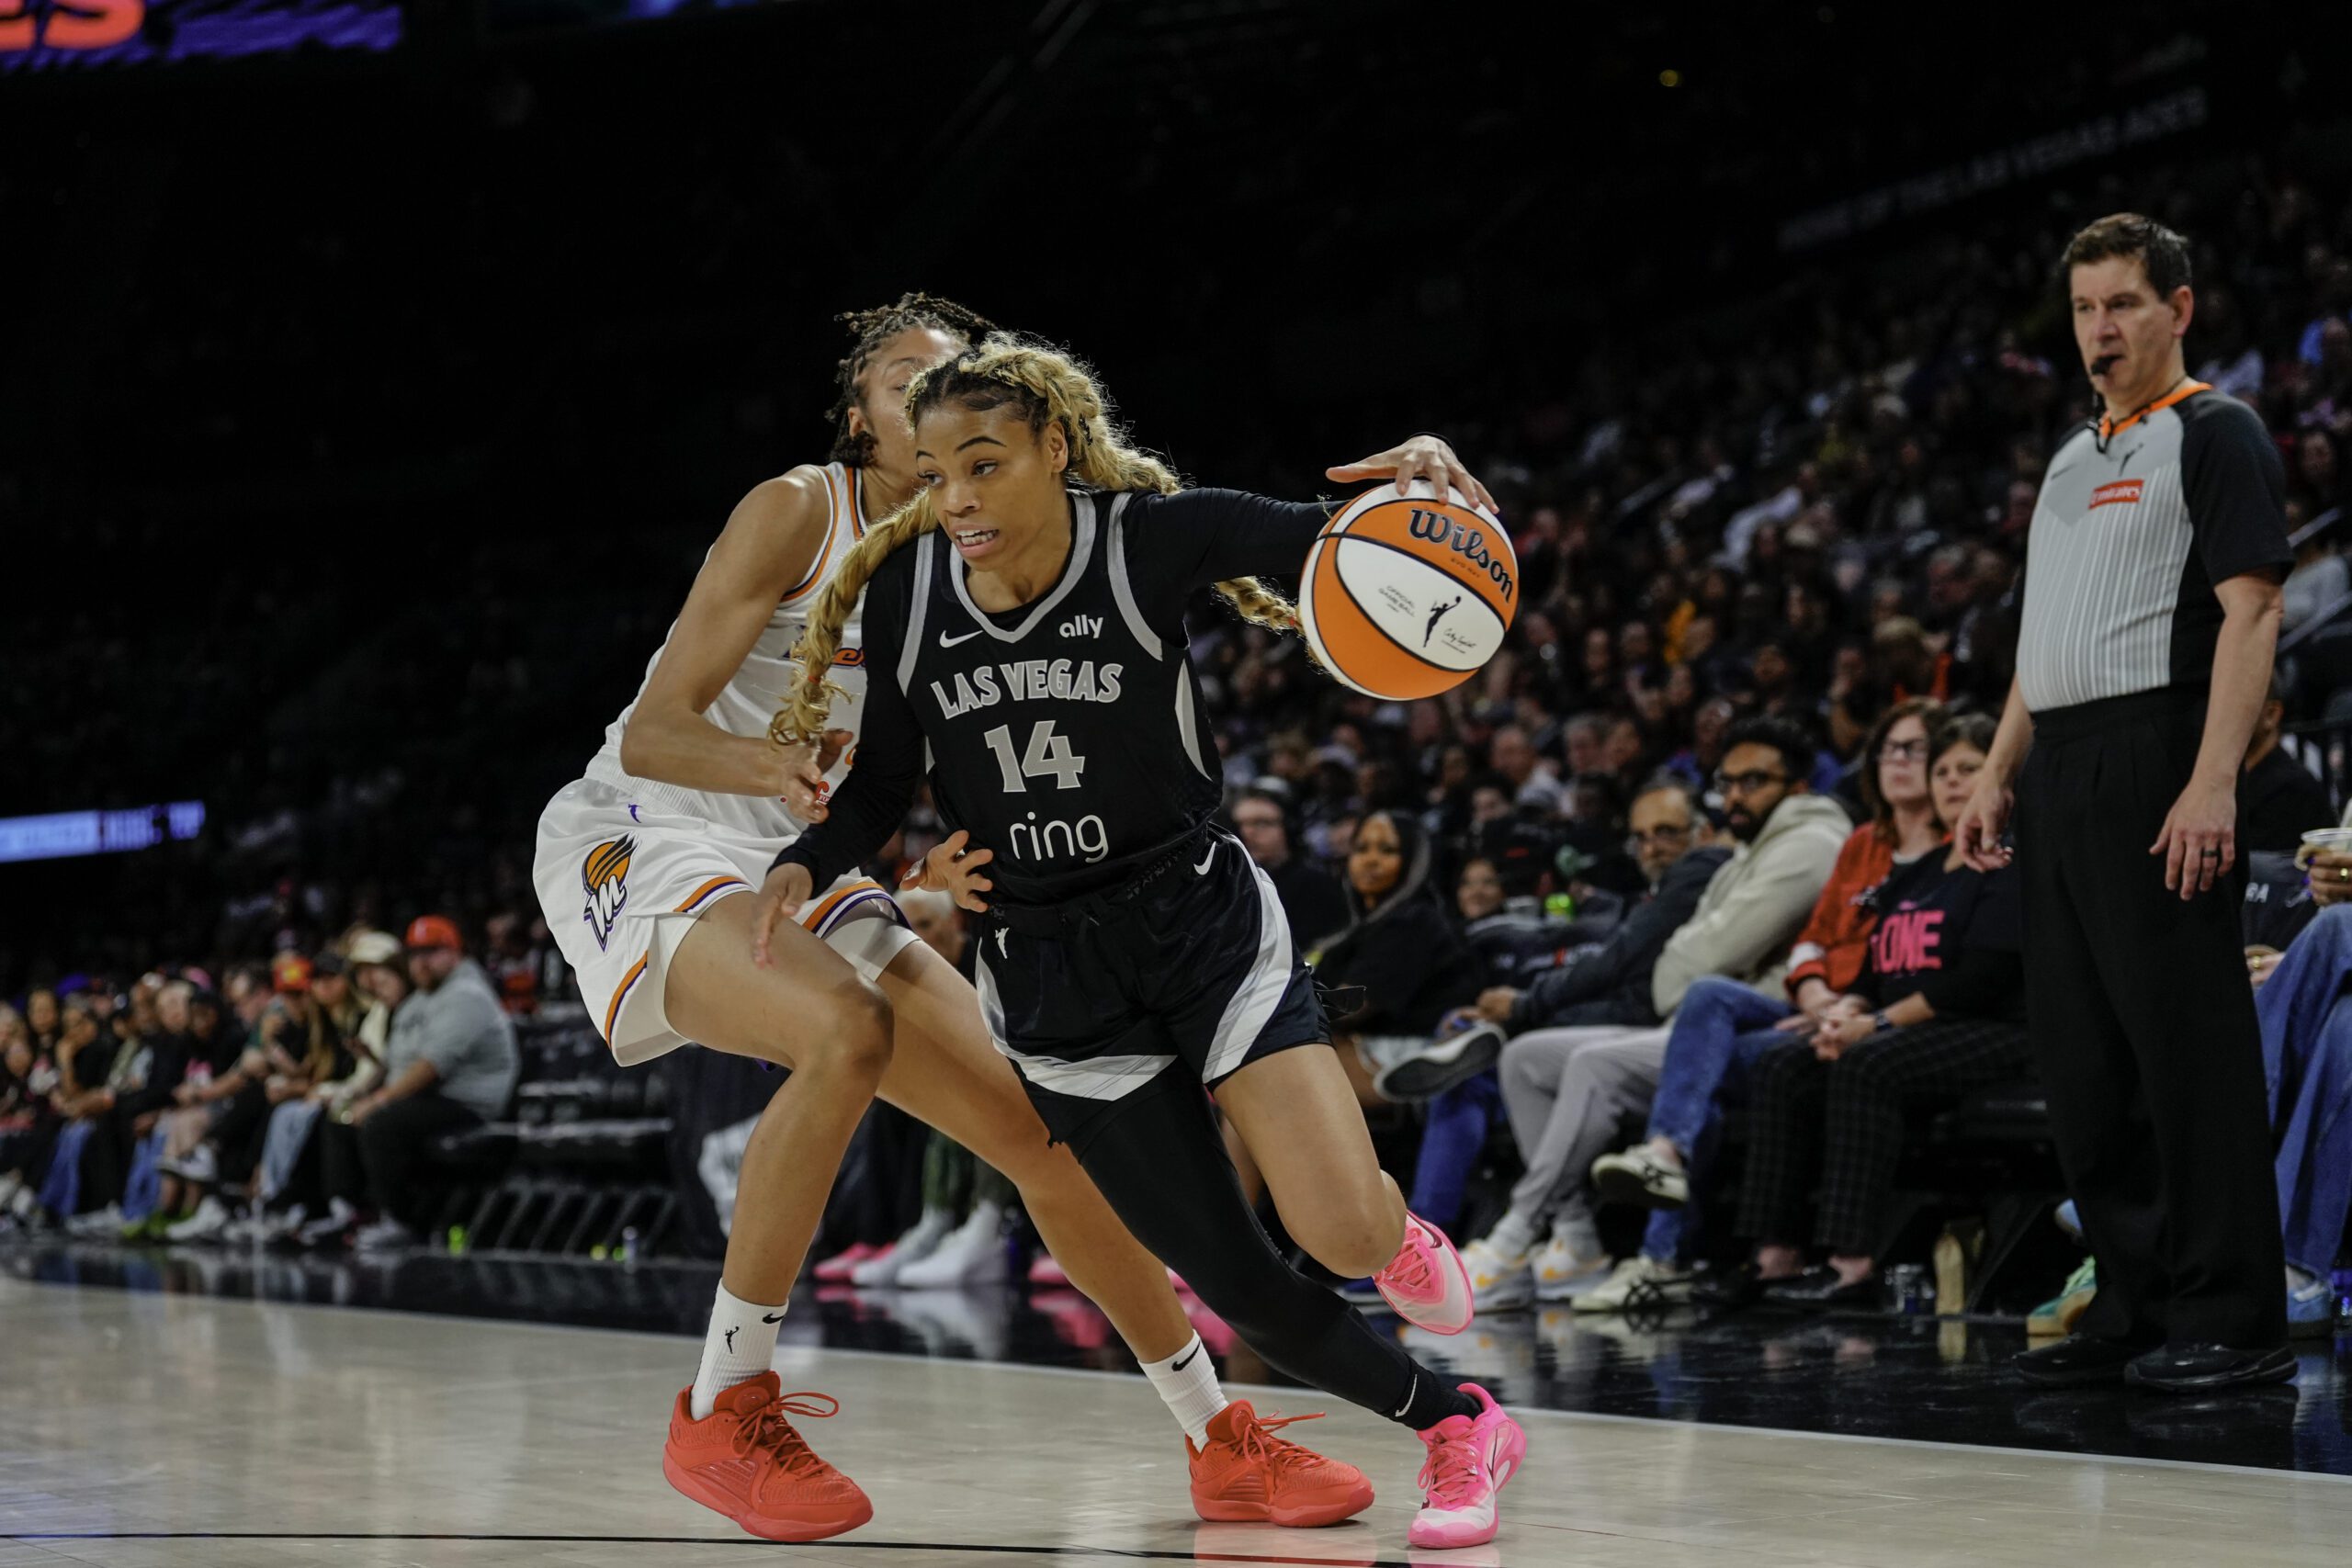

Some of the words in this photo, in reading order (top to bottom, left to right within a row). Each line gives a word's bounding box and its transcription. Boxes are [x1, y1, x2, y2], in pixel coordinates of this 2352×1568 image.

[1408, 508, 1514, 604] Wilson
[1059, 615, 1103, 639] ally
[930, 666, 1001, 720] LAS
[1000, 659, 1124, 703] VEGAS
[984, 720, 1086, 793] 14
[1010, 811, 1109, 863] ring
